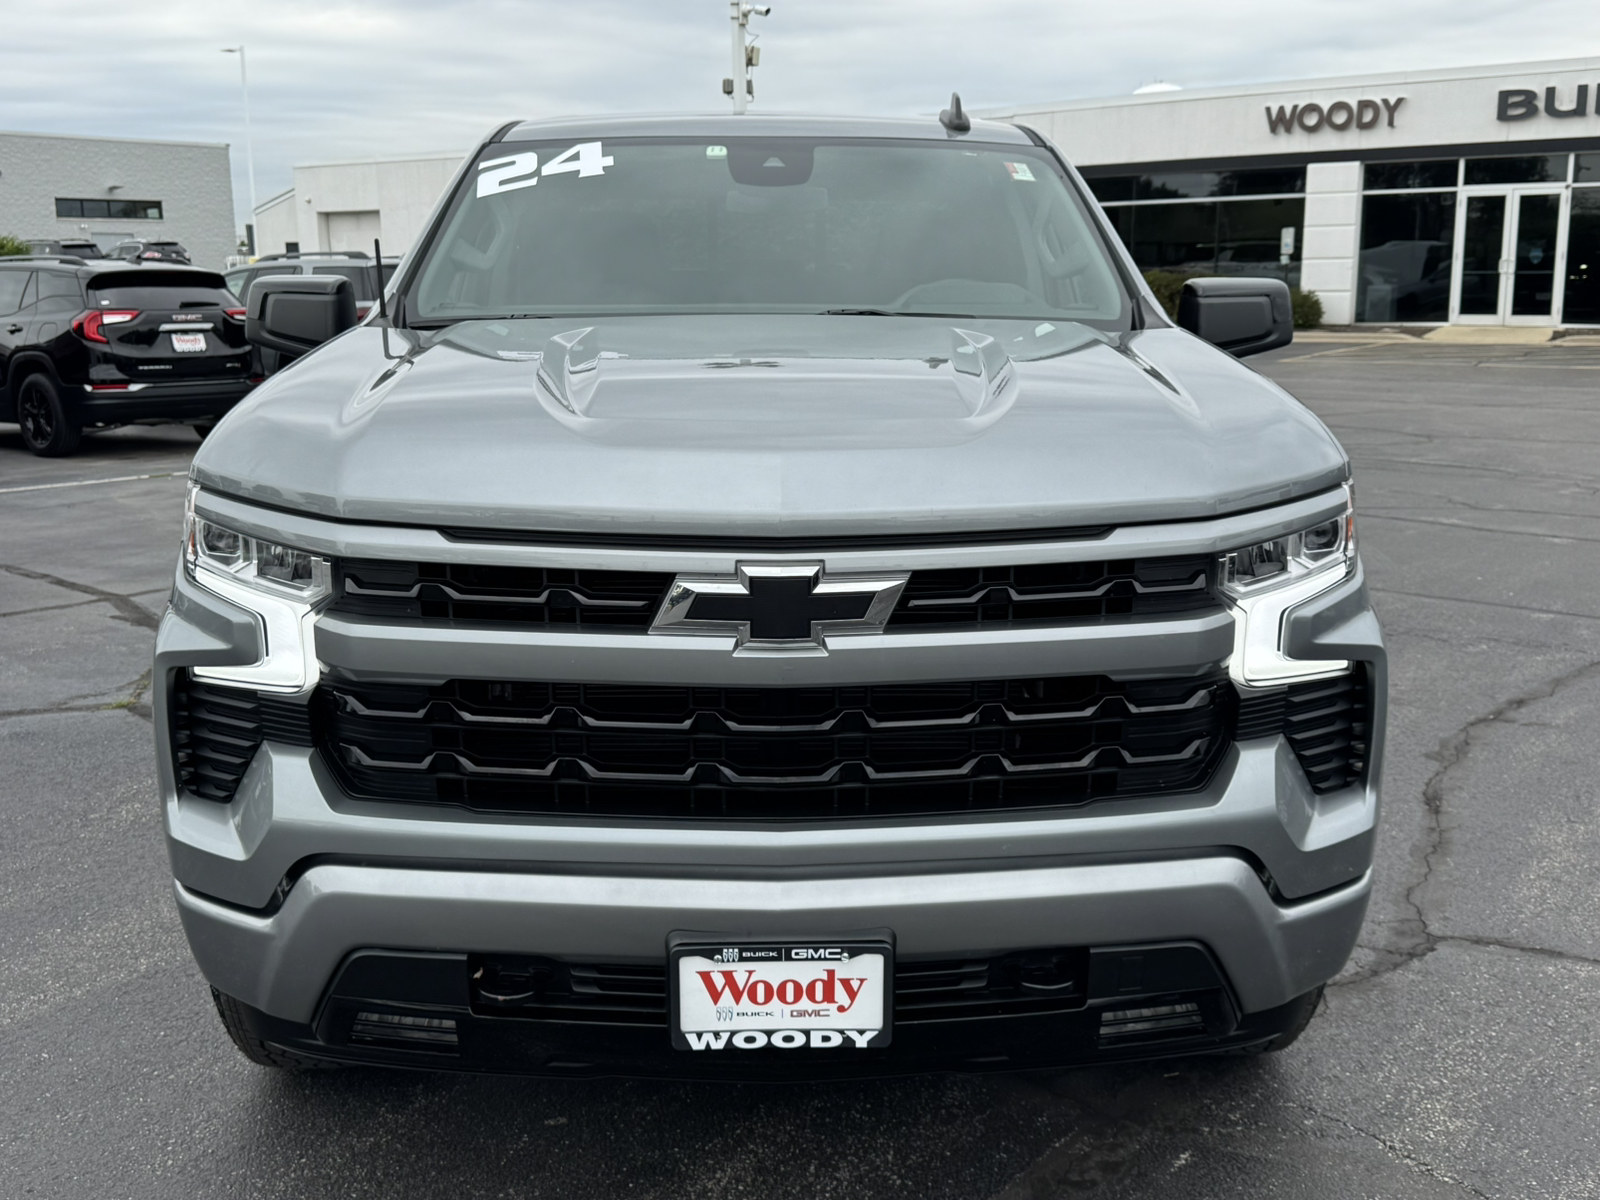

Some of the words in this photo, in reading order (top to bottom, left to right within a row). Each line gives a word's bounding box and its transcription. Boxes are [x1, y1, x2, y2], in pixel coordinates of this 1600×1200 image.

[1265, 97, 1406, 134] WOODY
[477, 141, 614, 198] 24
[791, 949, 841, 959] GMC
[695, 969, 868, 1013] Woody
[790, 1009, 830, 1017] GMC
[685, 1030, 879, 1050] WOODY
